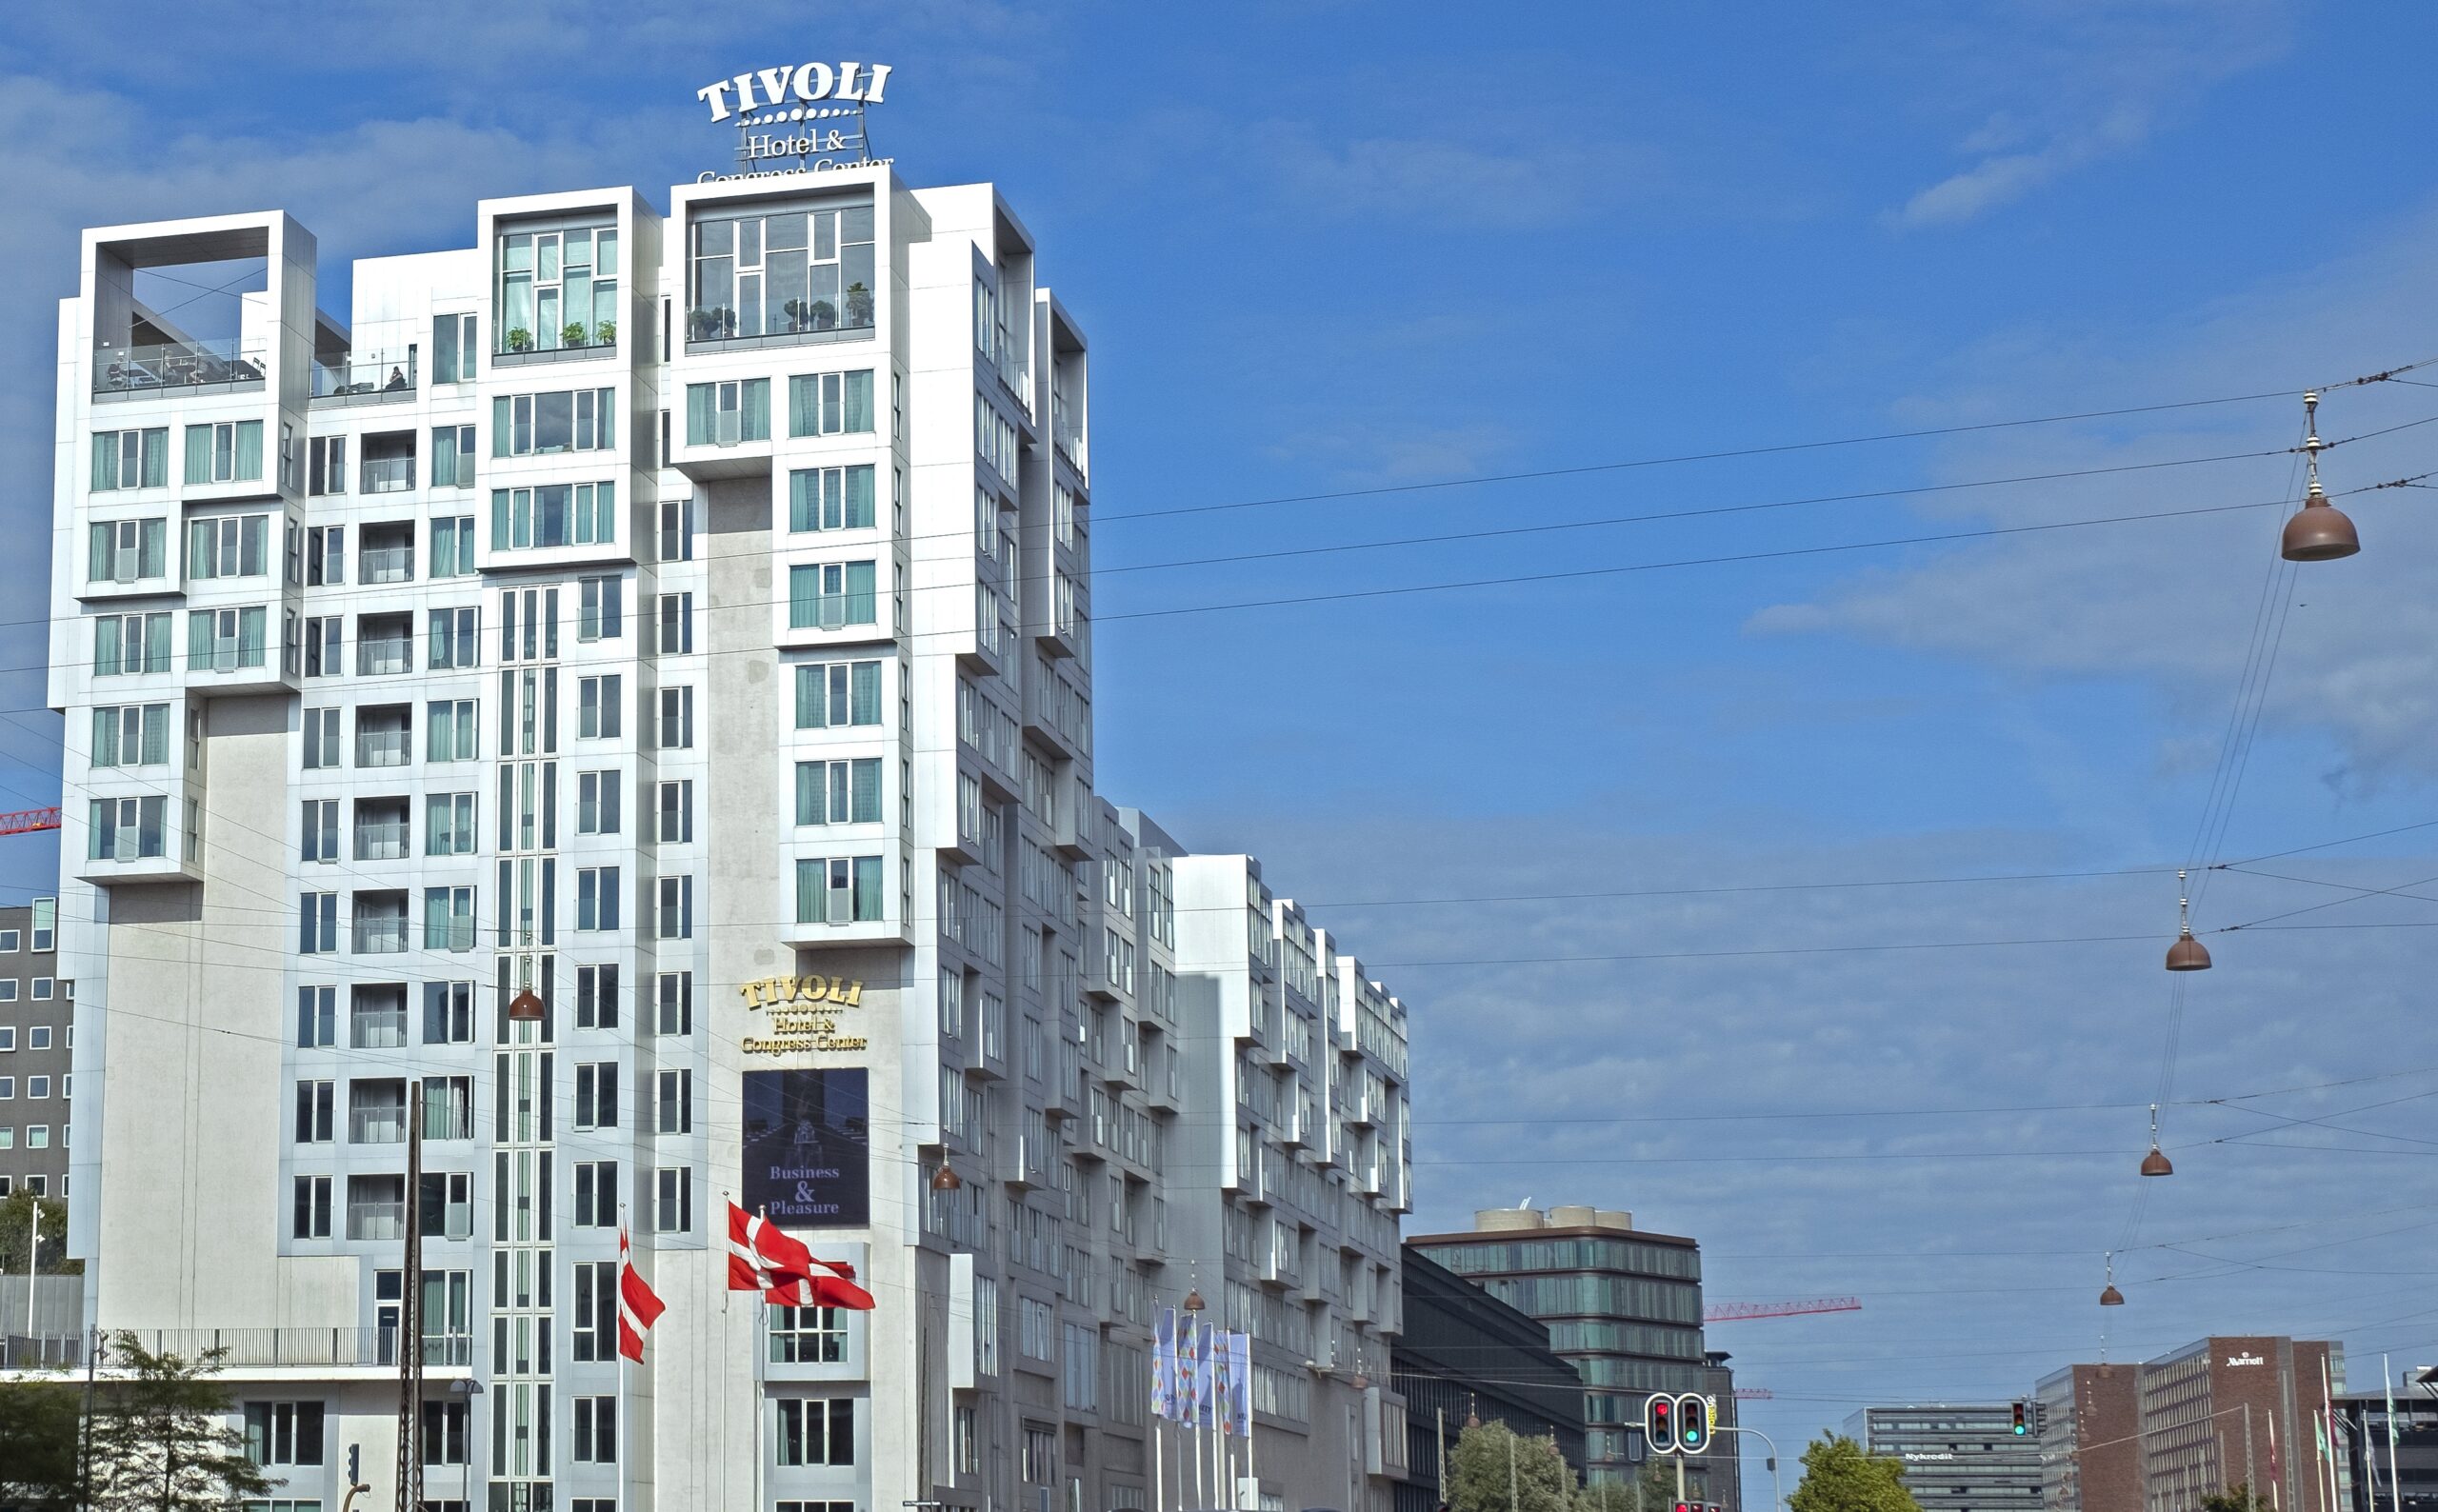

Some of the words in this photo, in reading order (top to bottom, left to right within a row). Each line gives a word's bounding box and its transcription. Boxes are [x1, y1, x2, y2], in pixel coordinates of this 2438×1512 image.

[697, 61, 892, 123] TIVOLI
[749, 129, 817, 159] Hotel
[827, 129, 846, 151] &
[739, 974, 863, 1010] TIVOLI
[773, 1016, 818, 1034] Hotel
[824, 1016, 836, 1034] &
[742, 1036, 811, 1056] Congress
[816, 1033, 868, 1051] Center
[769, 1165, 840, 1180] Business
[794, 1181, 814, 1203] &
[769, 1201, 839, 1216] Pleasure
[1905, 1453, 1953, 1462] Nykredit
